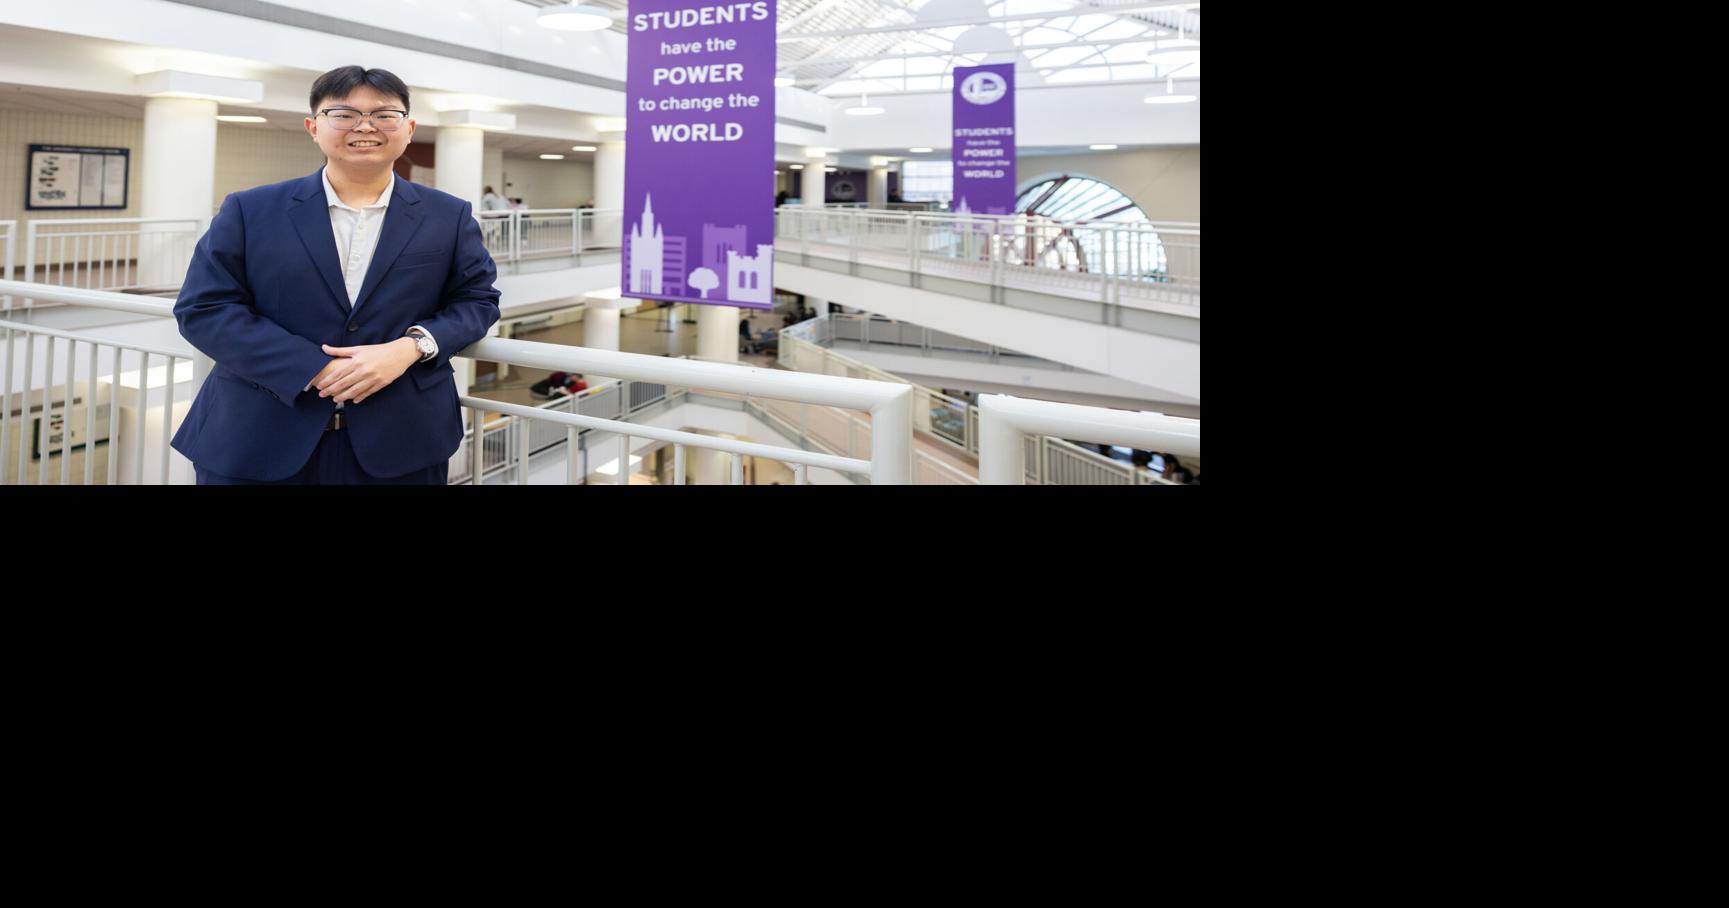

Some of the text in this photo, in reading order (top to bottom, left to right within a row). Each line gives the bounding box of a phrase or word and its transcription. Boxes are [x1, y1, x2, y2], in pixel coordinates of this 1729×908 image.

[633, 1, 769, 32] STUDENTS
[660, 37, 737, 56] have the
[653, 63, 745, 86] POWER
[638, 93, 760, 112] to change the
[651, 122, 744, 142] WORLD
[954, 127, 1014, 137] STUDENTS
[963, 148, 1004, 157] POWER
[963, 170, 1005, 178] WORLD
